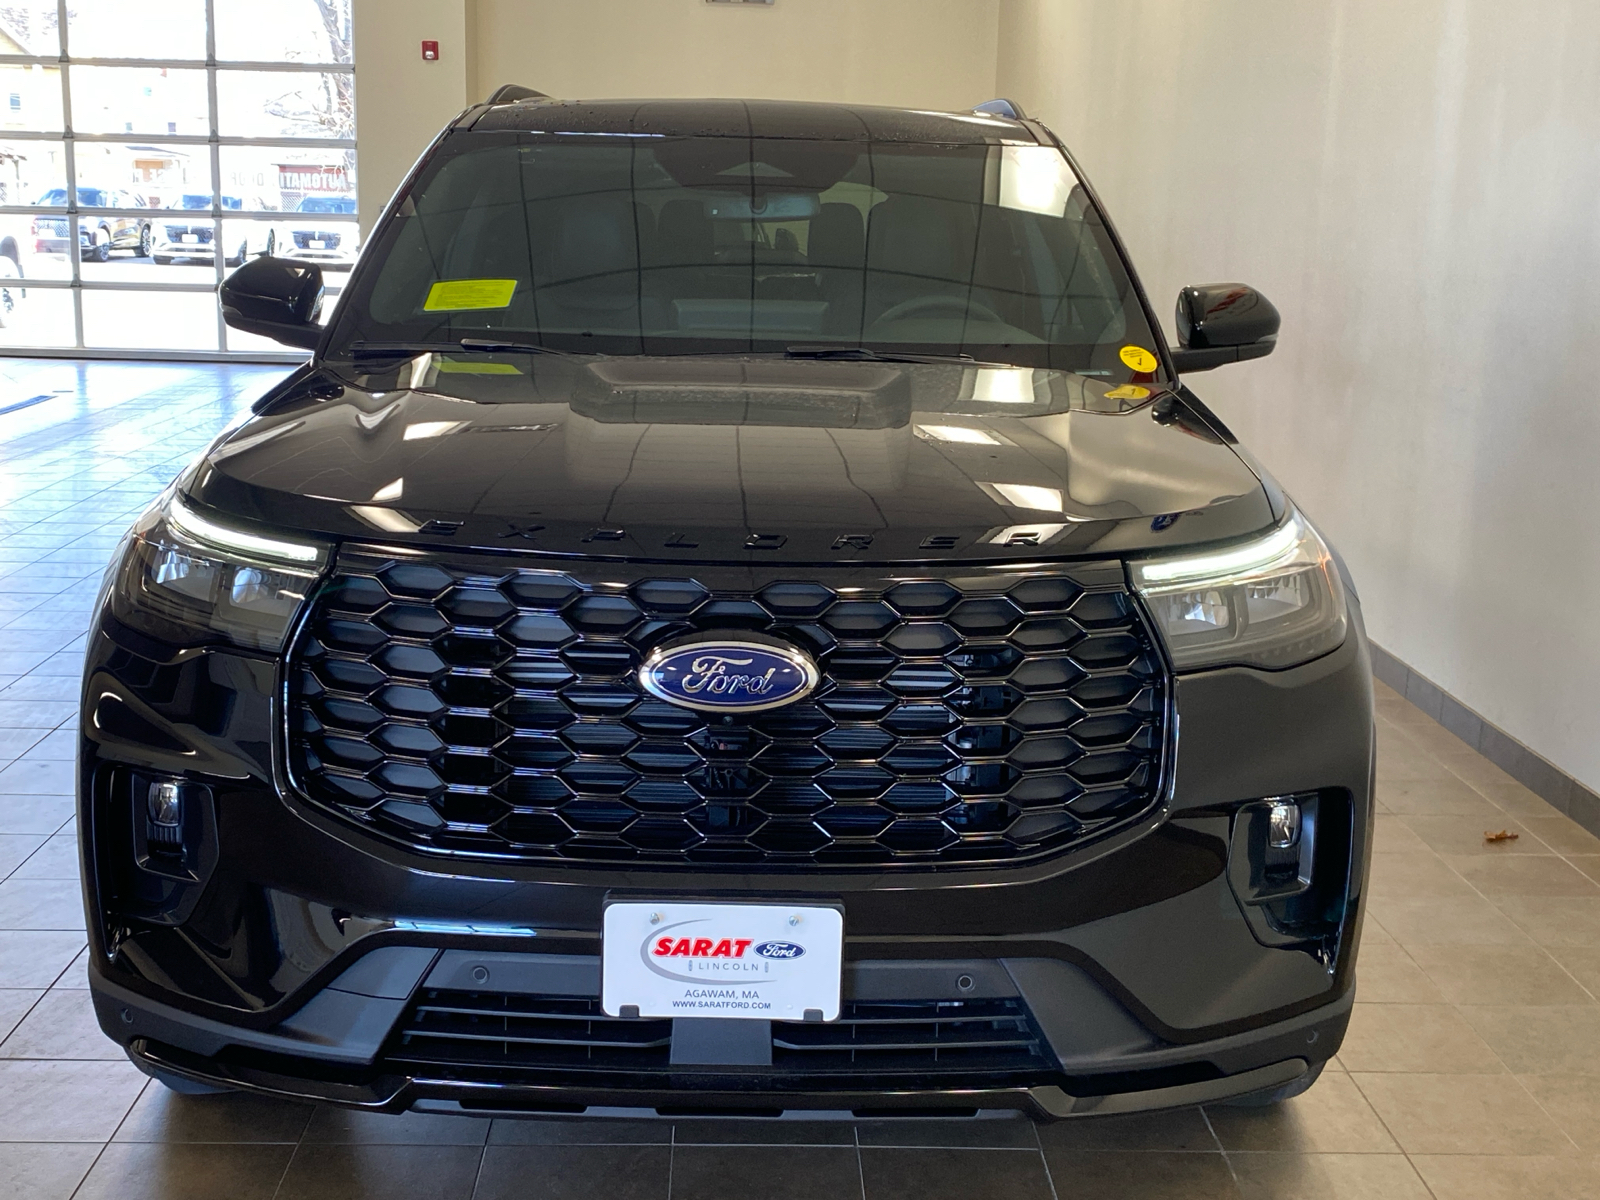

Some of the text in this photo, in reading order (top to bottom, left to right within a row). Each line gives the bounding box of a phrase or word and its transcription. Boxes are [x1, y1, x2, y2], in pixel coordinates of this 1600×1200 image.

[418, 519, 1043, 549] EXPLORER
[682, 655, 776, 695] Ford
[652, 936, 797, 958] SARAT Ford
[698, 962, 759, 971] LINCOLN
[684, 989, 760, 1000] AGAWAM, MA
[672, 1000, 771, 1009] WWW.SARATFORD.COM
